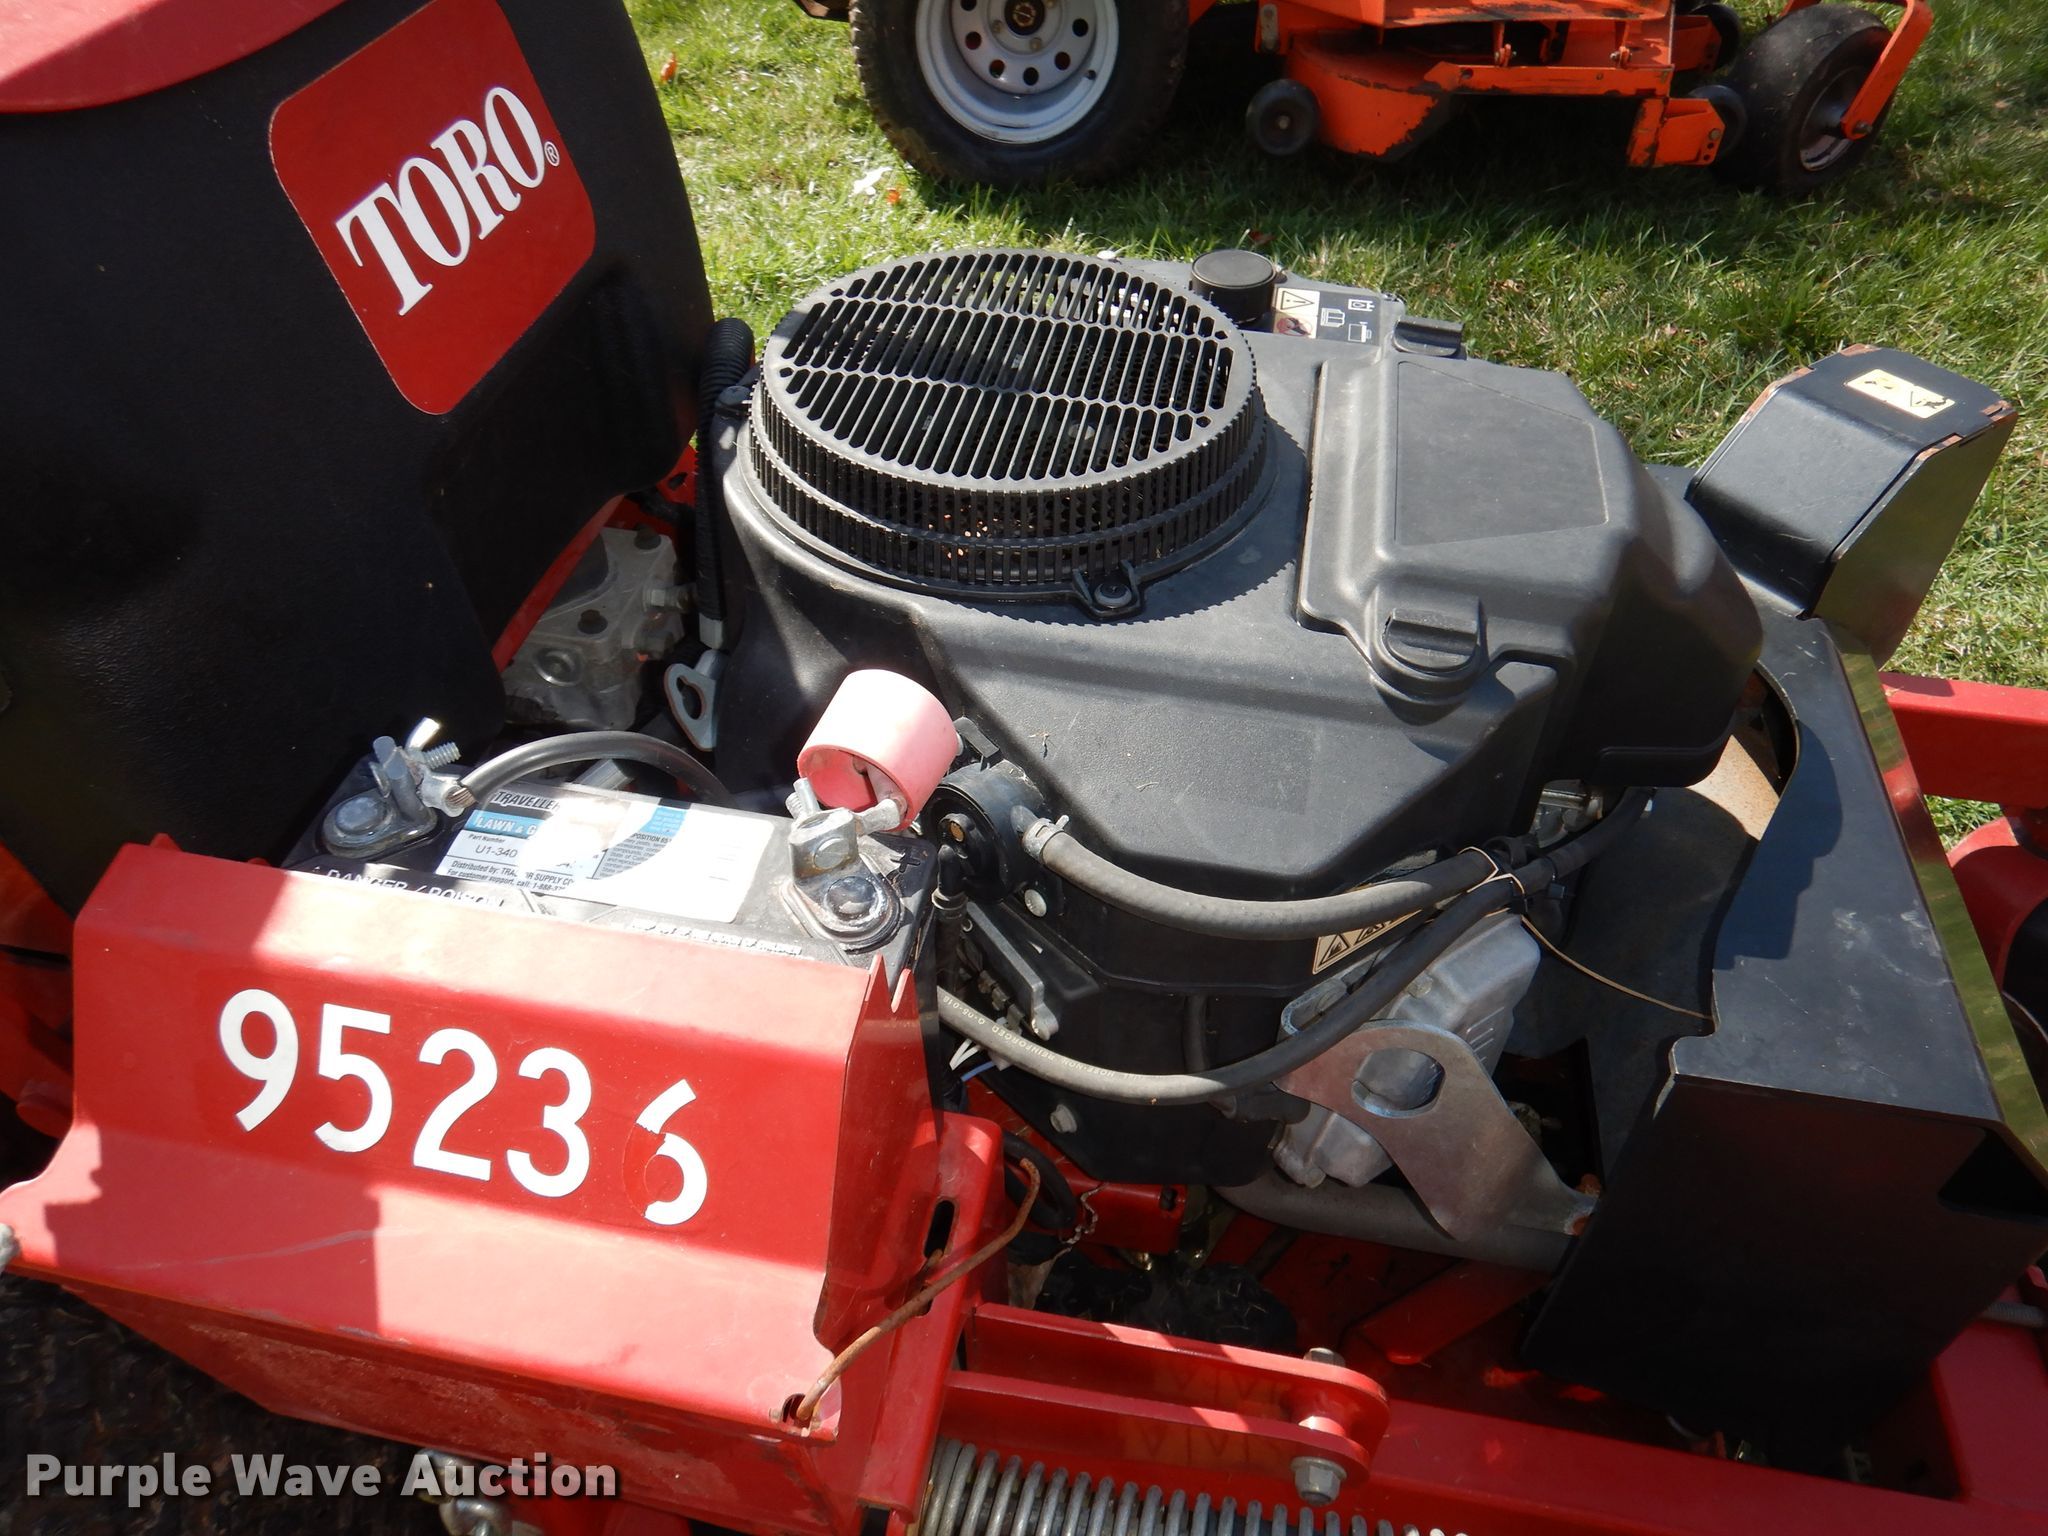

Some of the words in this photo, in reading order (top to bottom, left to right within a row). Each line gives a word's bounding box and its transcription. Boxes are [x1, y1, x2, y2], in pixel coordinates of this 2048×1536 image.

[334, 86, 546, 316] TORO
[474, 815, 516, 833] LAWN
[515, 825, 524, 834] &
[482, 836, 506, 844] Number
[474, 844, 519, 858] U1-340
[446, 868, 458, 877] For
[458, 871, 488, 881] customer
[451, 860, 488, 873] Distributed
[534, 872, 563, 884] SUPPLY
[219, 989, 708, 1226] 95236
